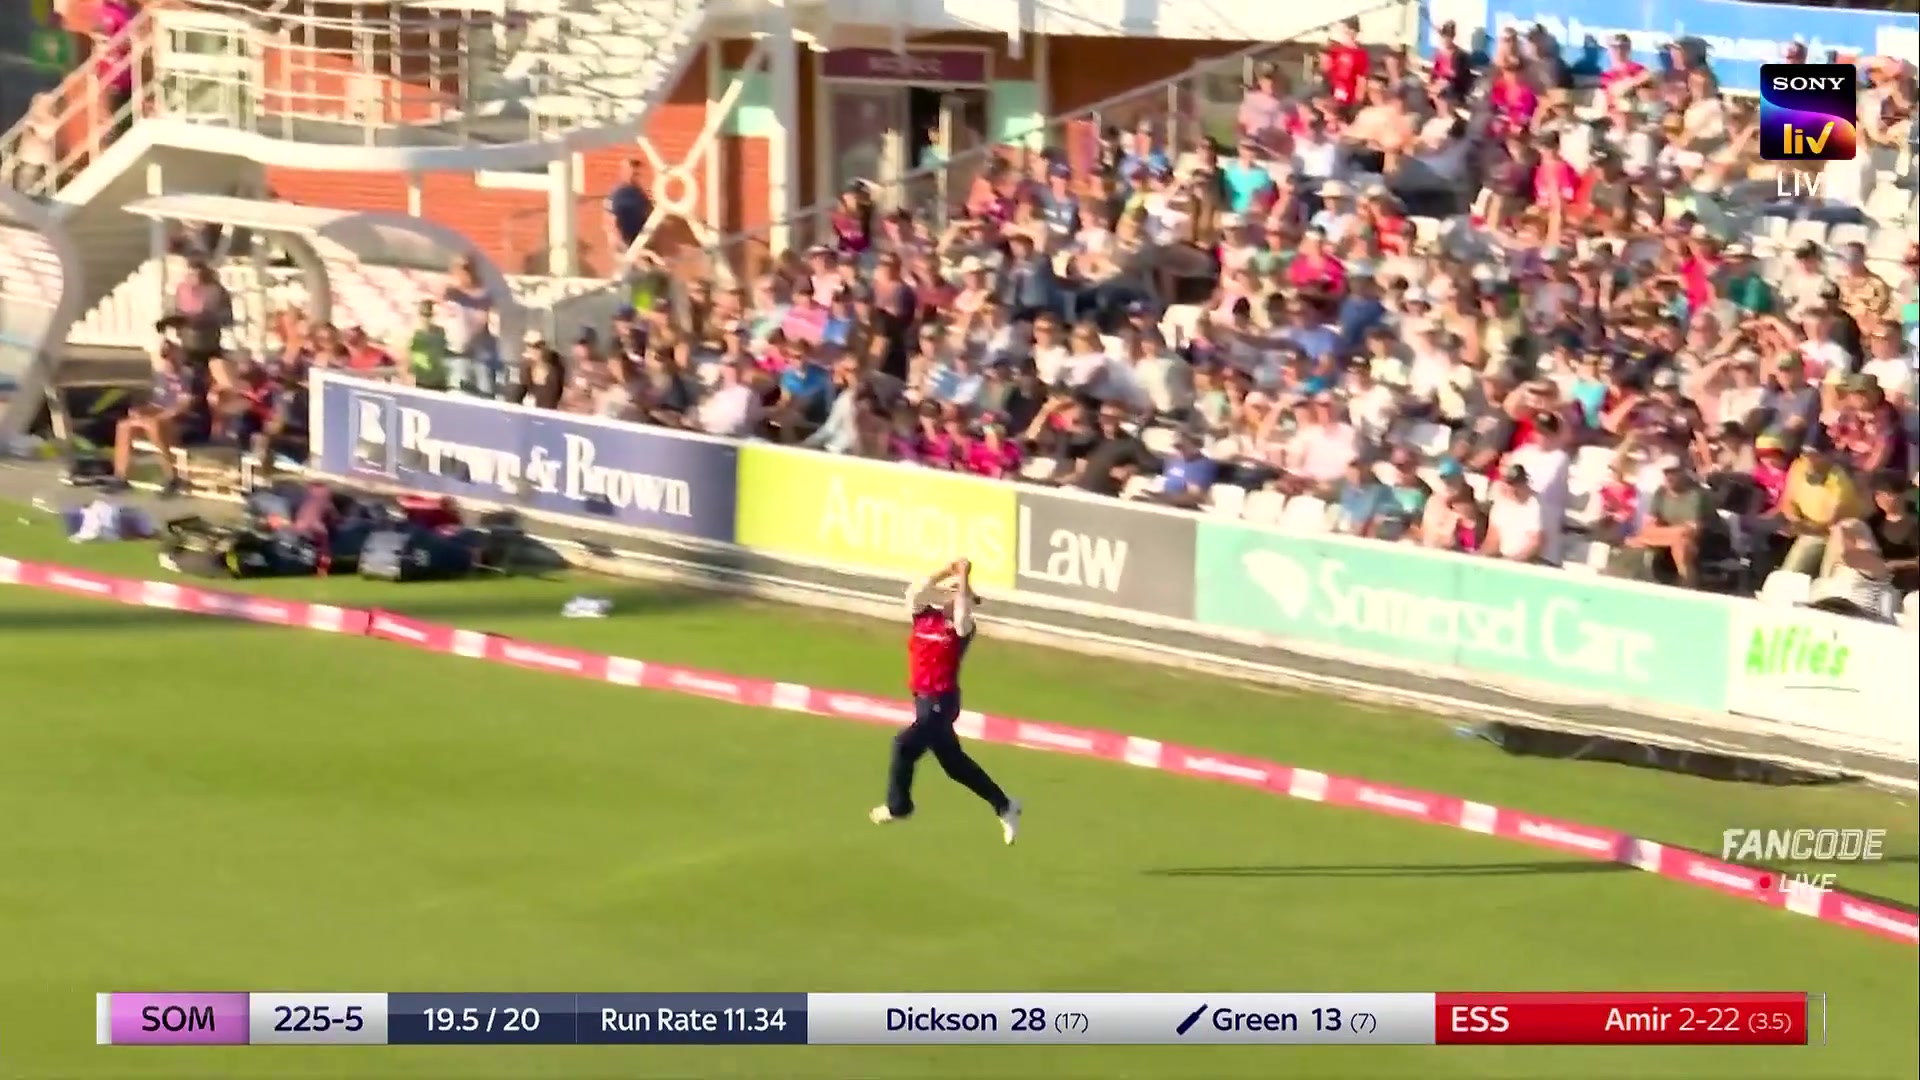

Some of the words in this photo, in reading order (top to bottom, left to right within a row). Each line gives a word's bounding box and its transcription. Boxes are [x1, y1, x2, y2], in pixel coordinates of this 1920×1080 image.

[526, 444, 563, 494] &
[562, 432, 693, 518] Brown
[816, 473, 1007, 571] Amicus
[1018, 503, 1129, 593] Law
[1313, 558, 1531, 660] Somerset
[1541, 594, 1658, 684] Care
[1745, 624, 1851, 679] Alfie's
